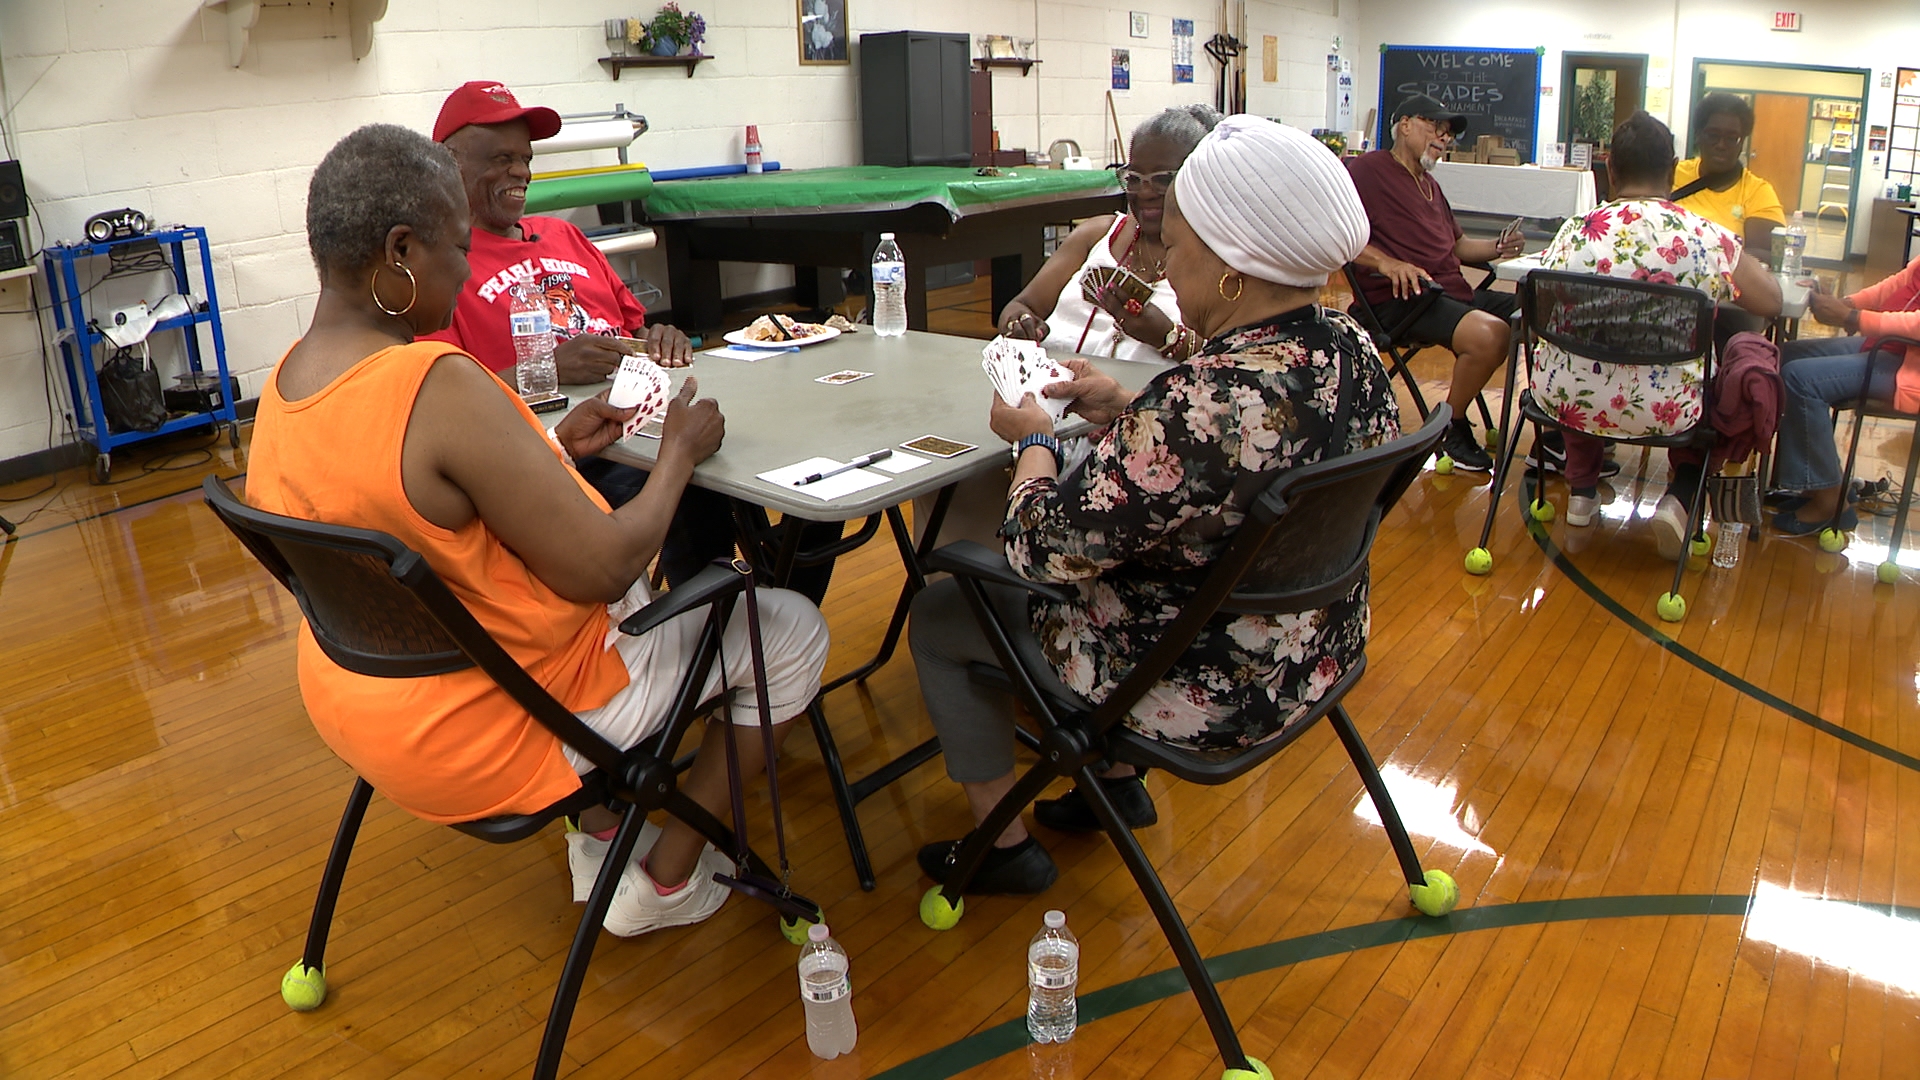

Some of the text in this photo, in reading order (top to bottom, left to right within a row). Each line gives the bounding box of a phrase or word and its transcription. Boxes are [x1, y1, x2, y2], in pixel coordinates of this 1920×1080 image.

[1775, 12, 1796, 28] EXIT
[1417, 53, 1514, 69] WELCOME
[1430, 71, 1488, 82] TO THE
[1397, 82, 1503, 102] SPADES
[477, 258, 542, 303] PEARL
[539, 257, 590, 279] HIGH
[547, 272, 572, 288] 1966
